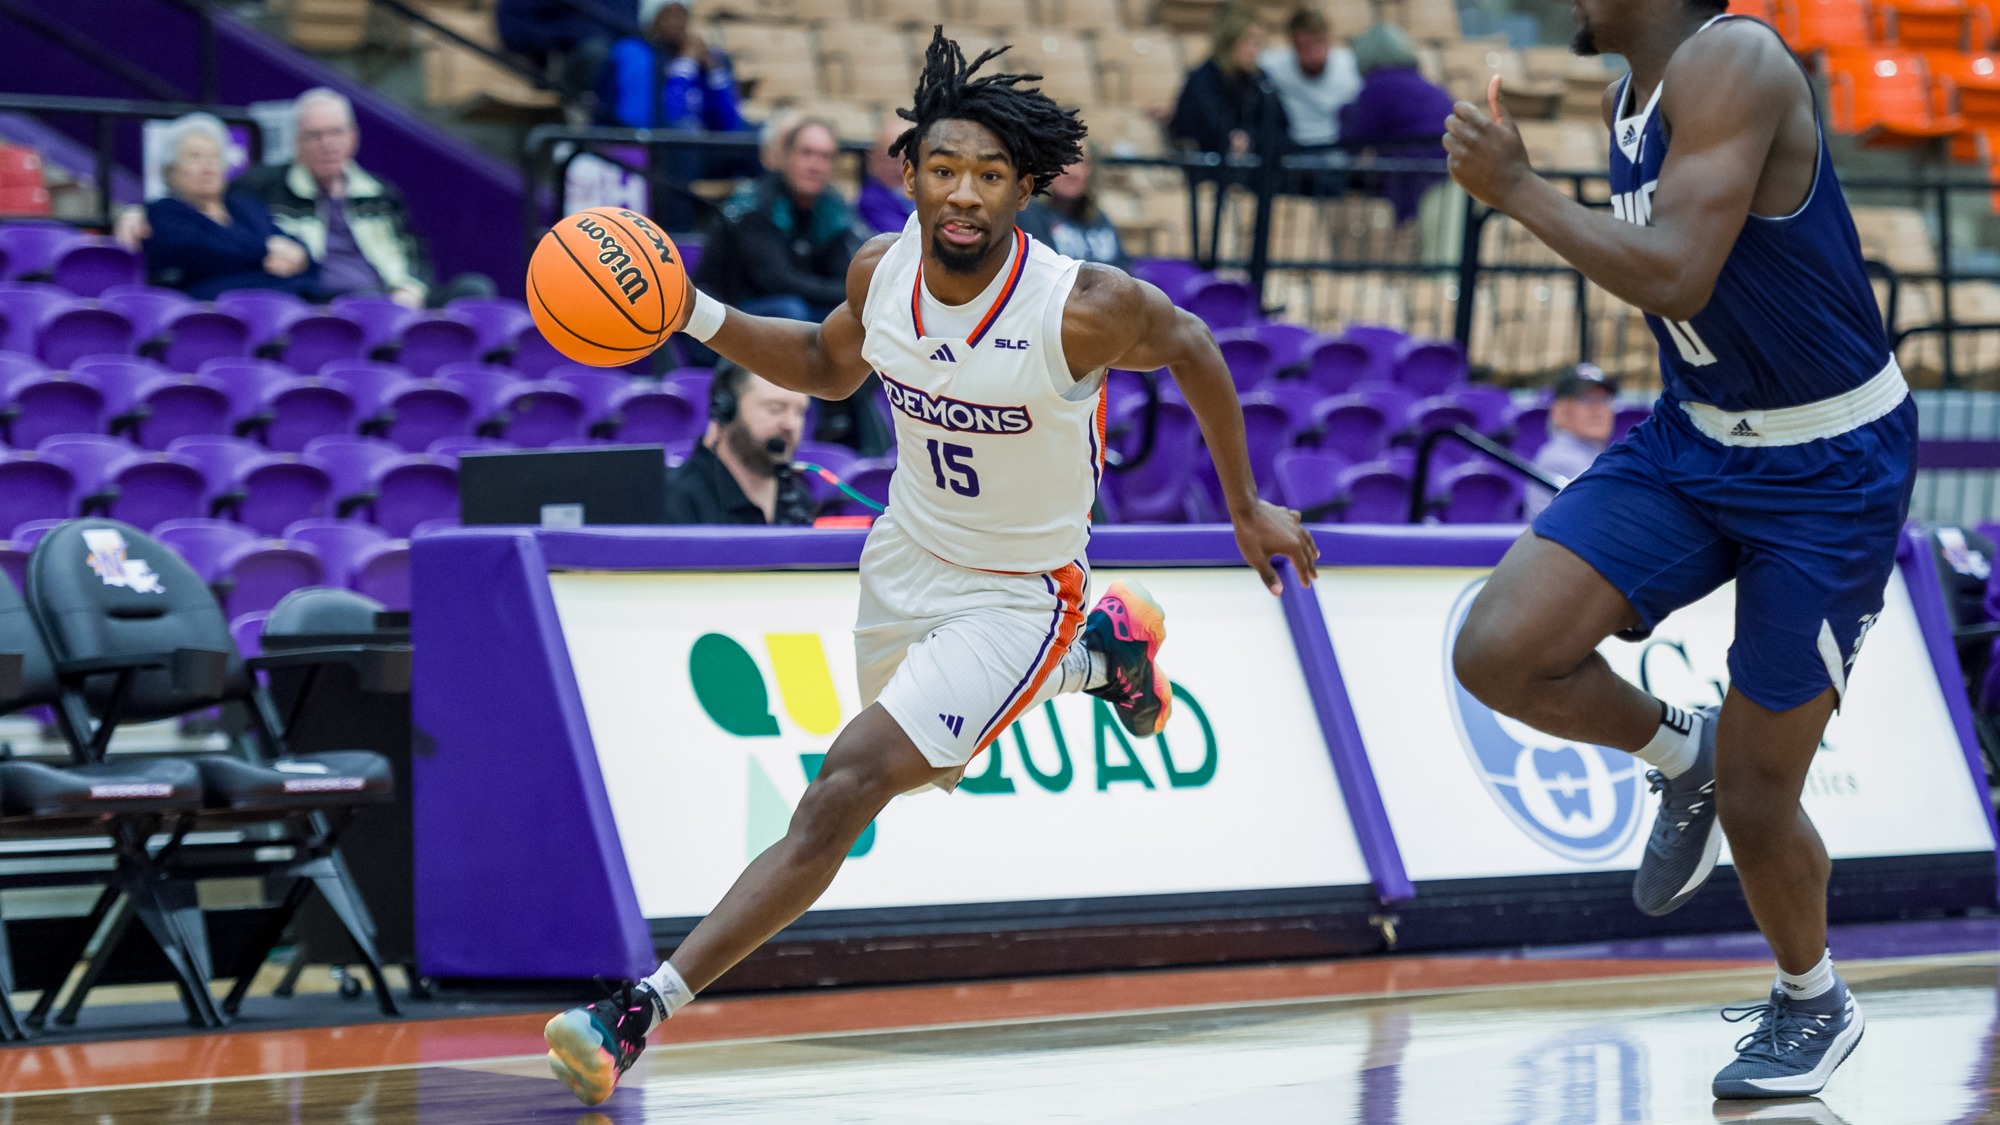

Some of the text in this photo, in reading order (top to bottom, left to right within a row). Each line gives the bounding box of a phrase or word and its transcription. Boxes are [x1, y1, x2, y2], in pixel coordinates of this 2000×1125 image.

[576, 217, 650, 306] Wilson
[618, 211, 676, 265] NCAA
[994, 338, 1031, 350] SLC
[885, 380, 1029, 432] DEMONS
[926, 438, 981, 498] 15
